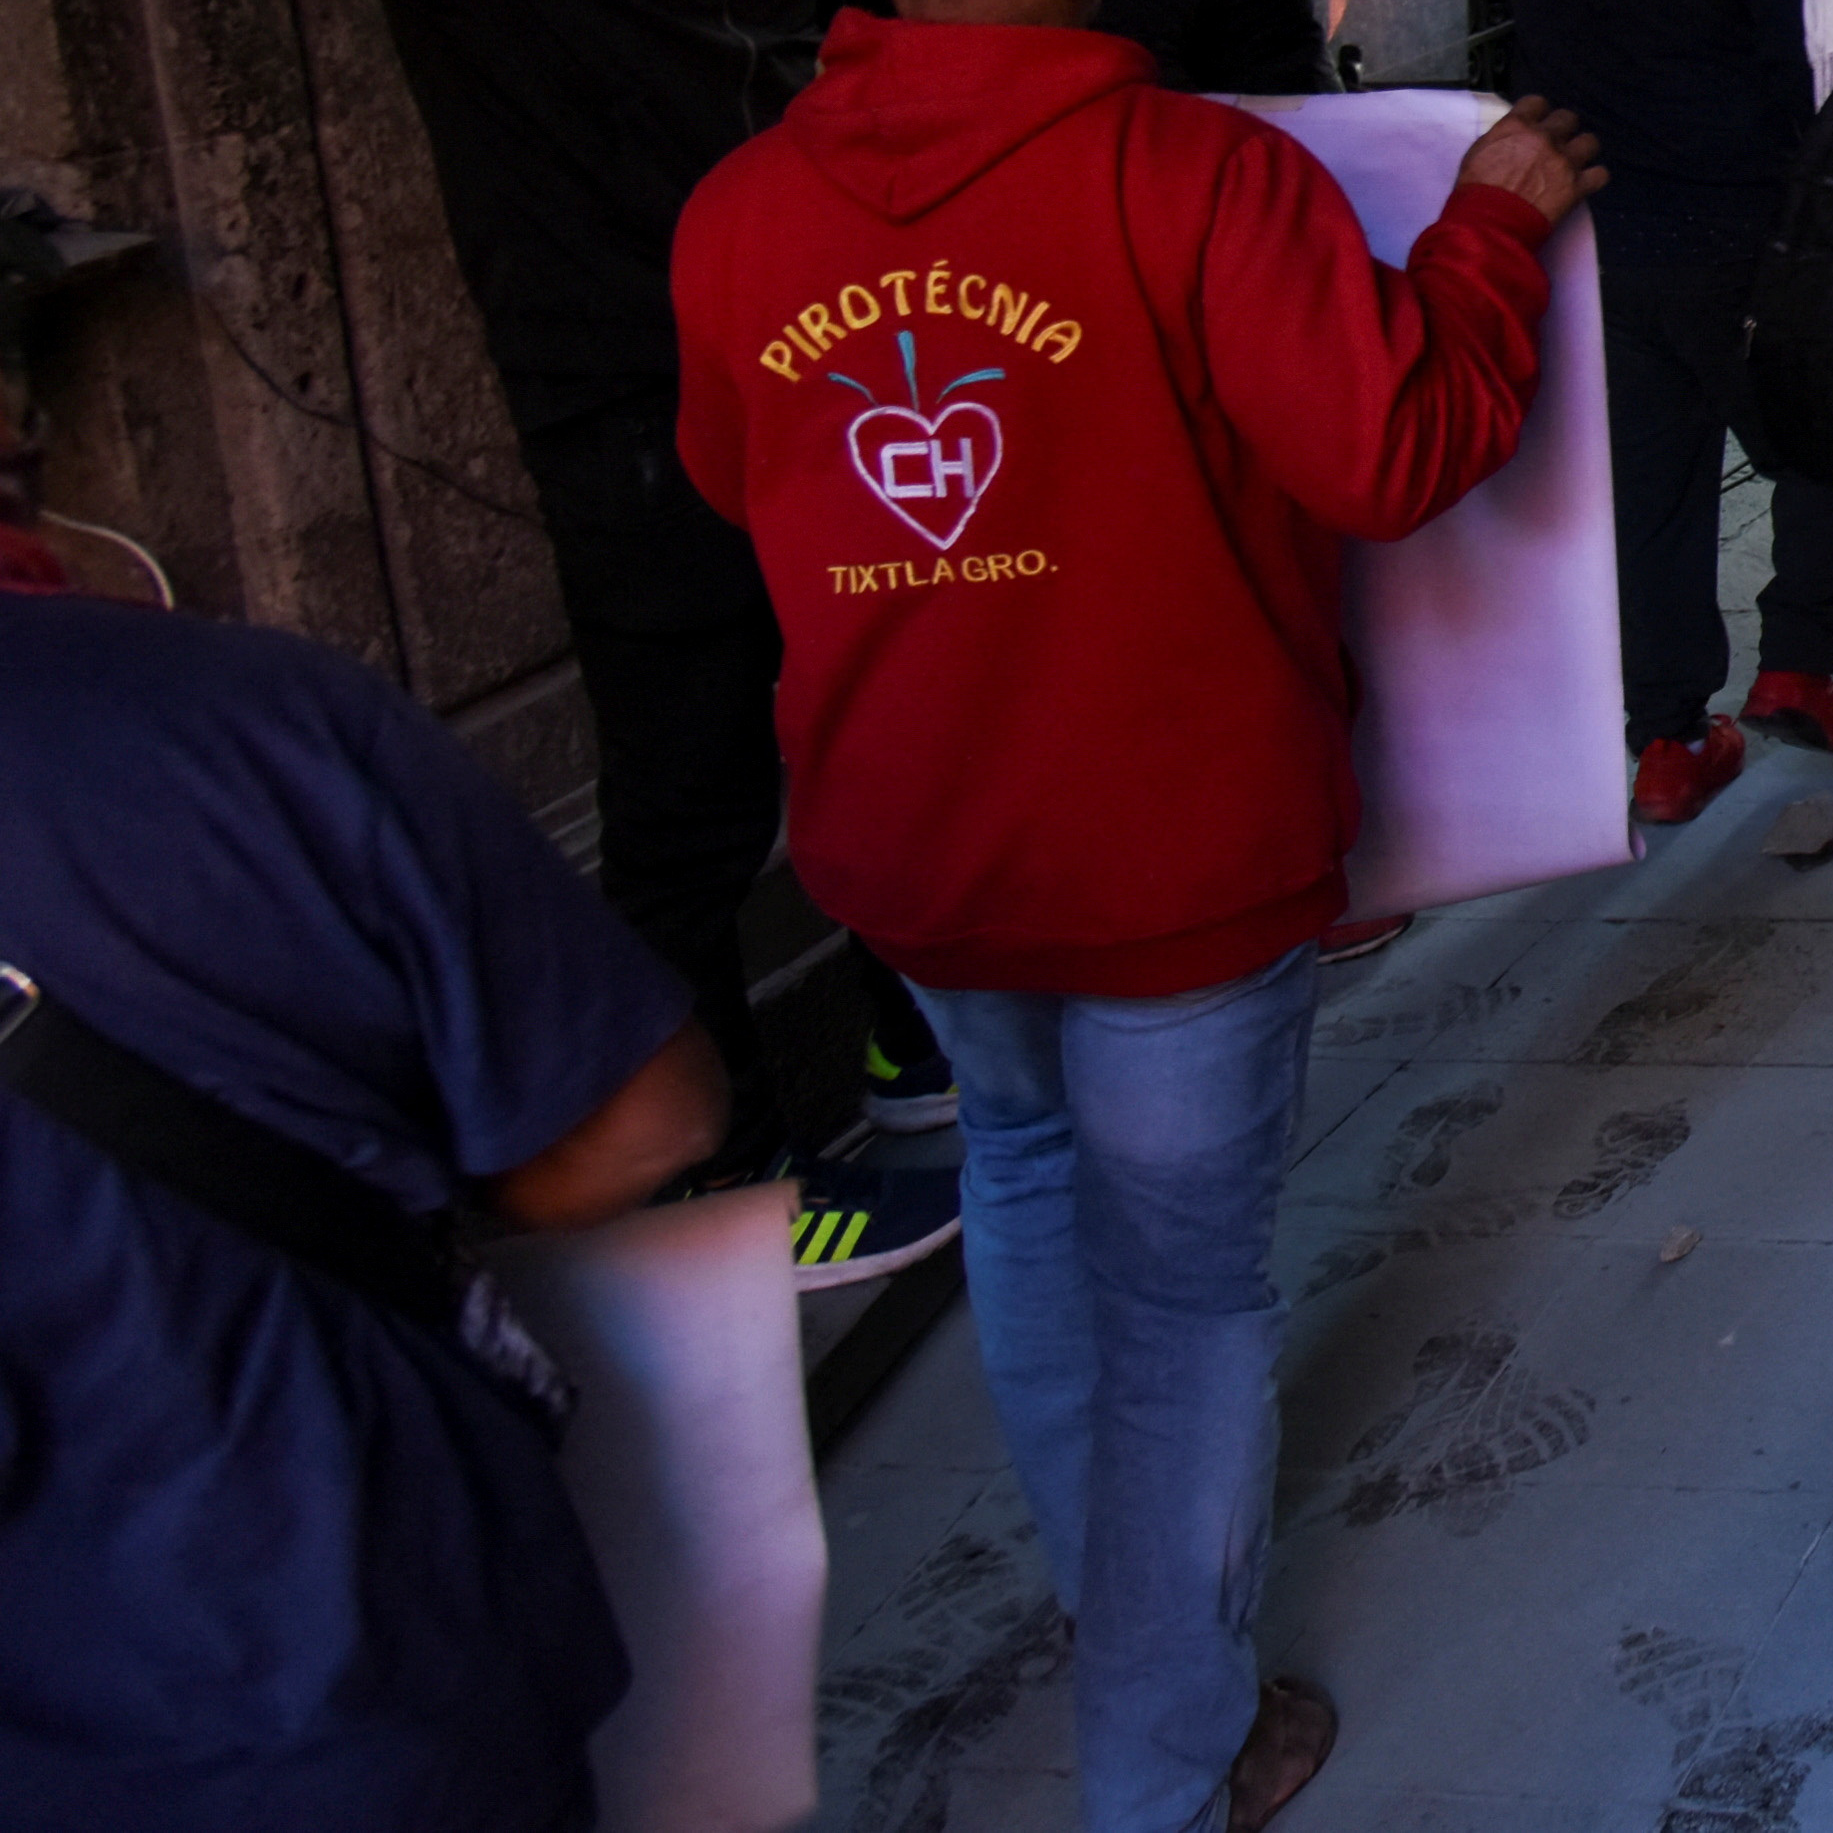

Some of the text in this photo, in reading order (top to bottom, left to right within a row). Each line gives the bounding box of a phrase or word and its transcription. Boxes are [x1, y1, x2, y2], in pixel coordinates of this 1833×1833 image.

[759, 259, 1083, 383] PIROTÉCNIA
[879, 436, 975, 498] CH
[827, 548, 1060, 594] TIXTLA GRO.
